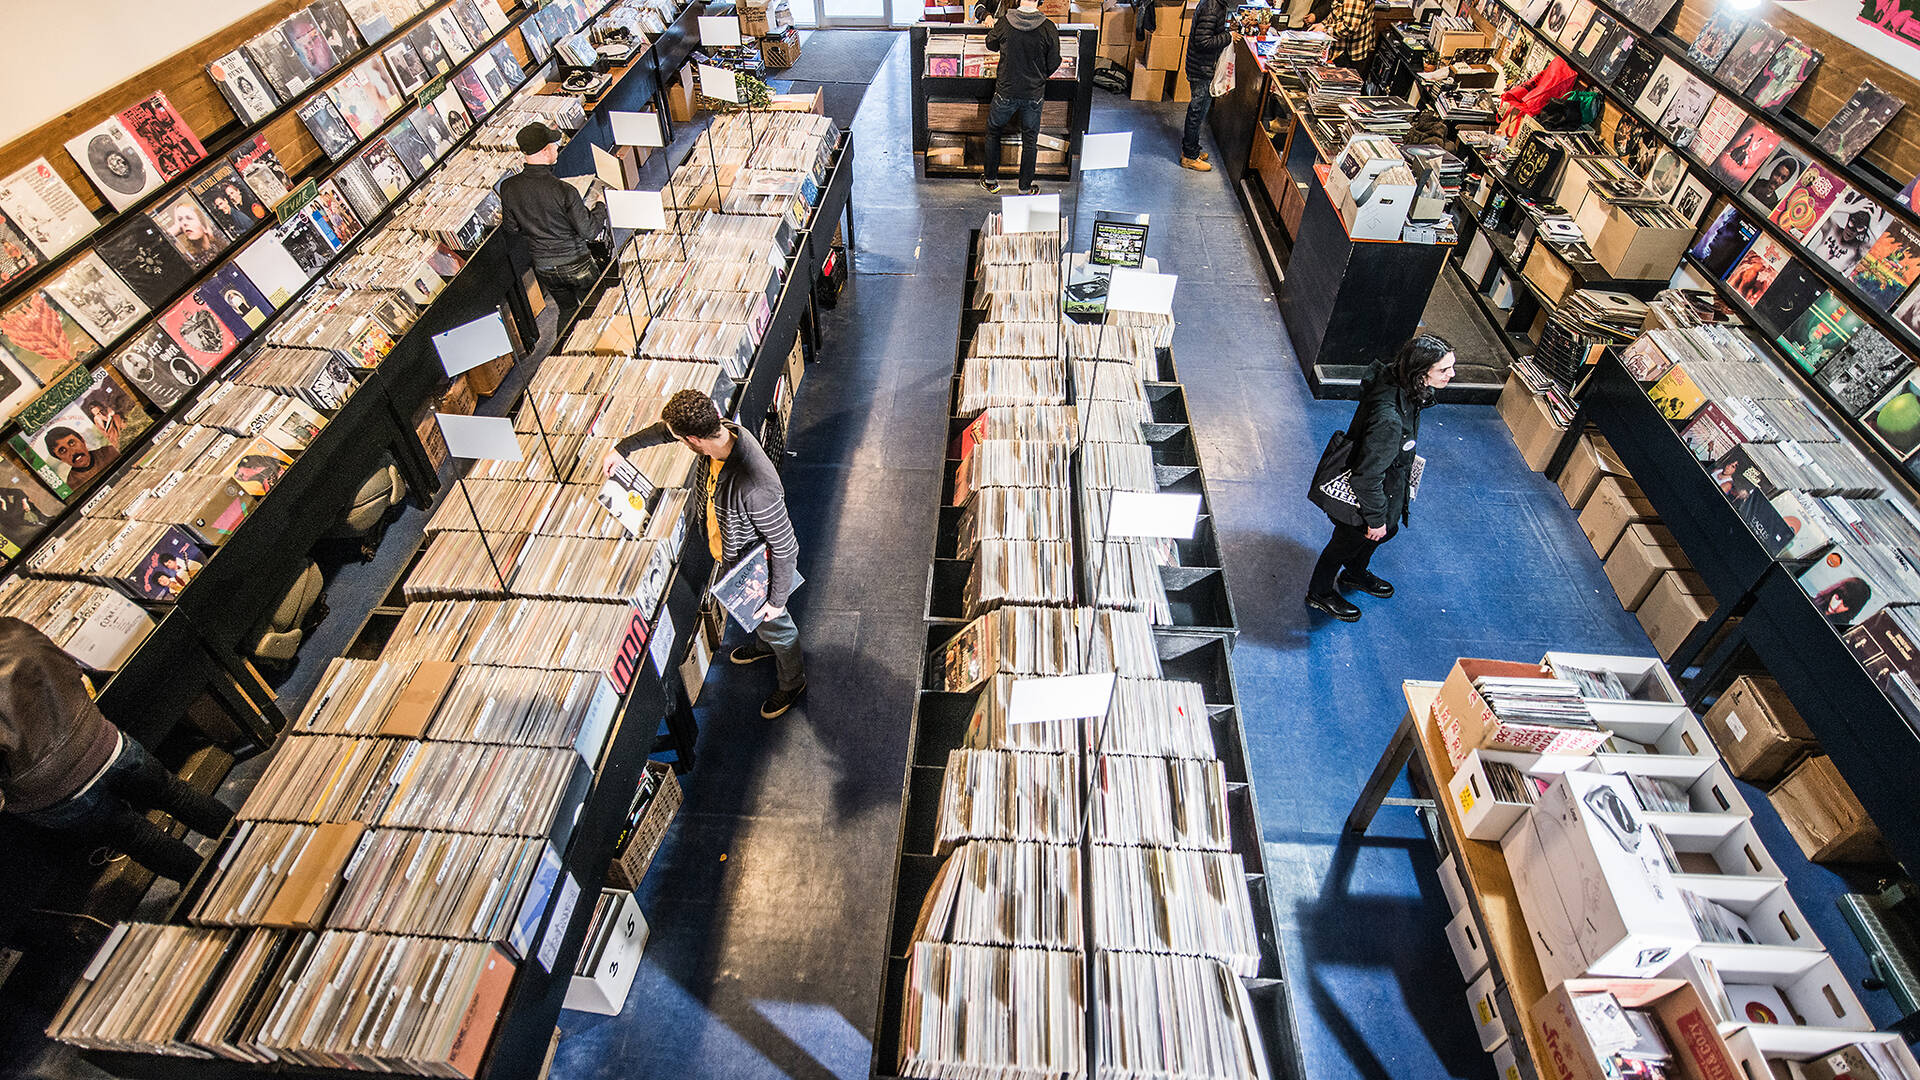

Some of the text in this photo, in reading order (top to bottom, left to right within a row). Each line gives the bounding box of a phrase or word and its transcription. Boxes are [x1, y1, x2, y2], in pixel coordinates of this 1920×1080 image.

[227, 66, 245, 79] PUNK
[133, 340, 149, 353] SIX
[147, 340, 162, 358] FEET
[159, 344, 180, 361] UNDER
[1689, 1023, 1711, 1055] COZY
